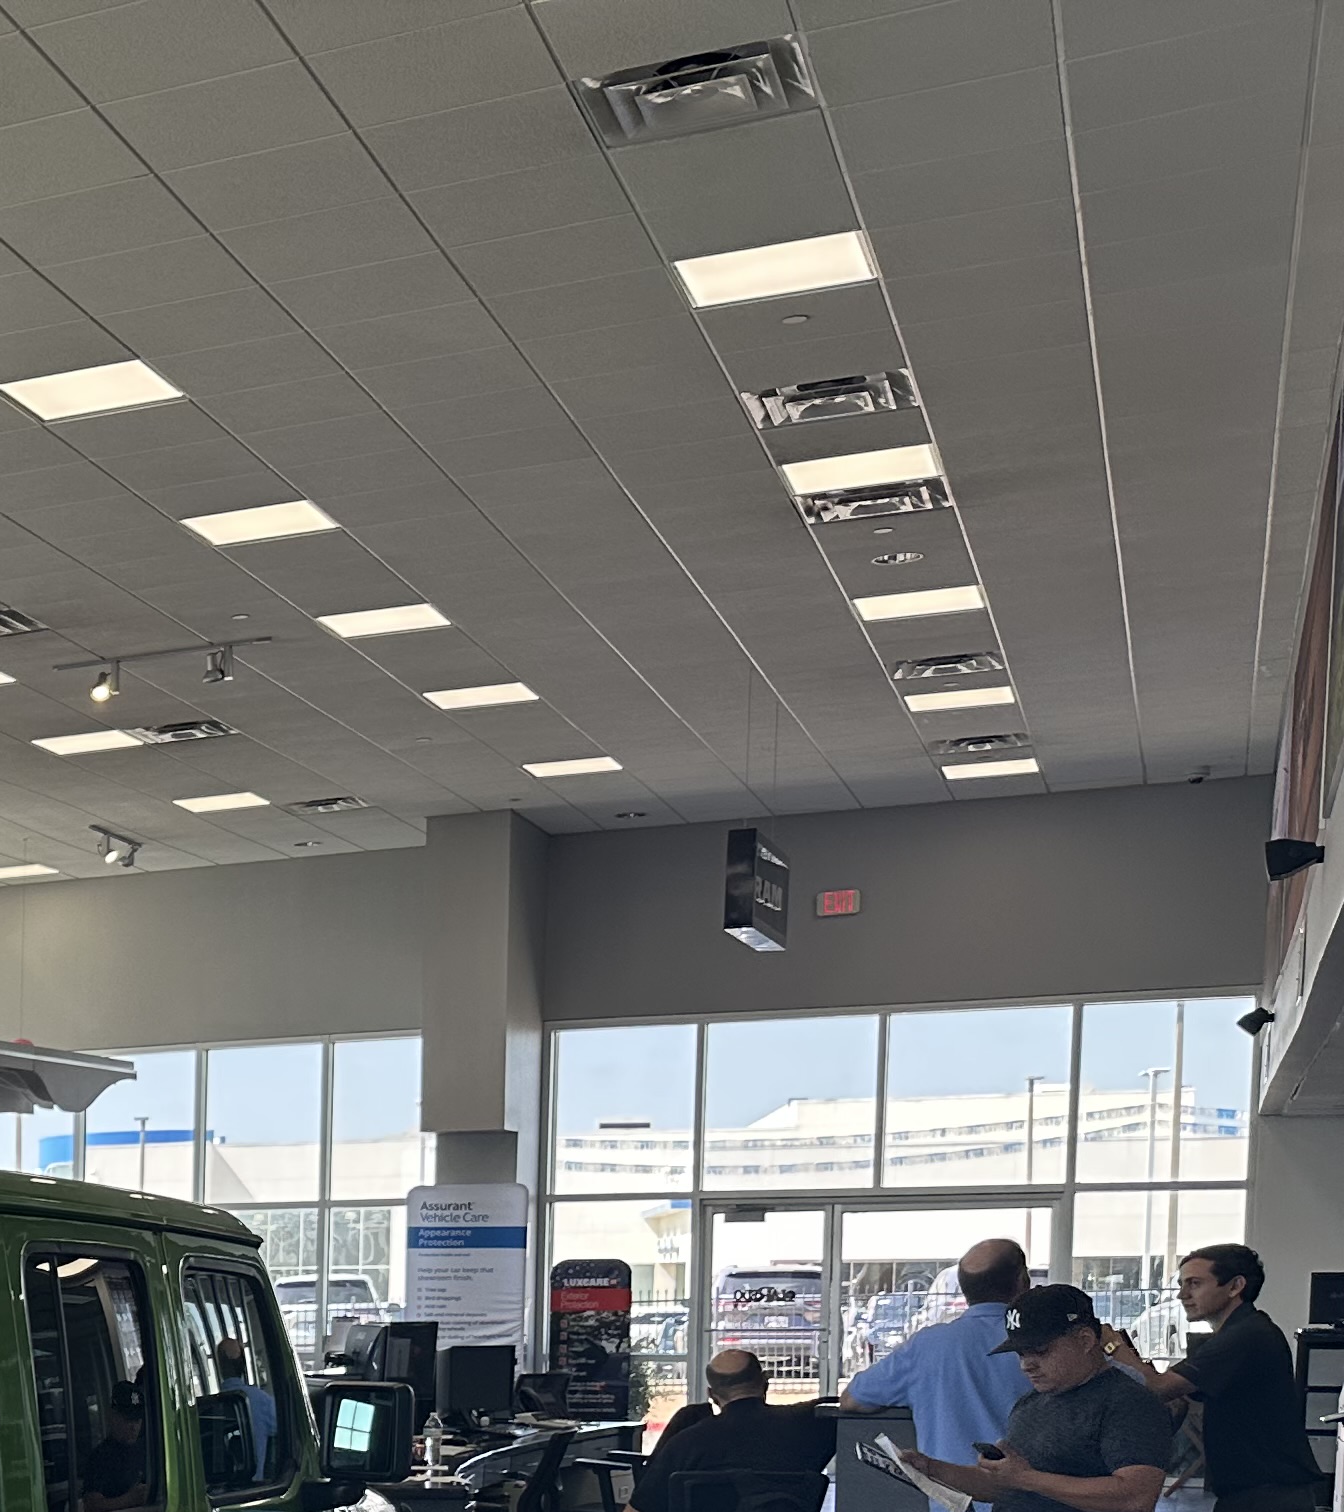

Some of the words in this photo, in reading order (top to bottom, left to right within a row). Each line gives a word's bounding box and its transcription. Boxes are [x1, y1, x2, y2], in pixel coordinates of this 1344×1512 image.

[754, 876, 784, 911] RAM
[823, 889, 856, 914] EXIT
[420, 1201, 473, 1212] Assurant
[420, 1212, 462, 1223] Vehicle
[462, 1212, 490, 1223] Care
[418, 1228, 472, 1238] Appearance
[418, 1238, 465, 1247] Protection
[563, 1277, 610, 1287] LUXCARE
[561, 1291, 590, 1300] Exterior
[561, 1300, 599, 1309] Protection
